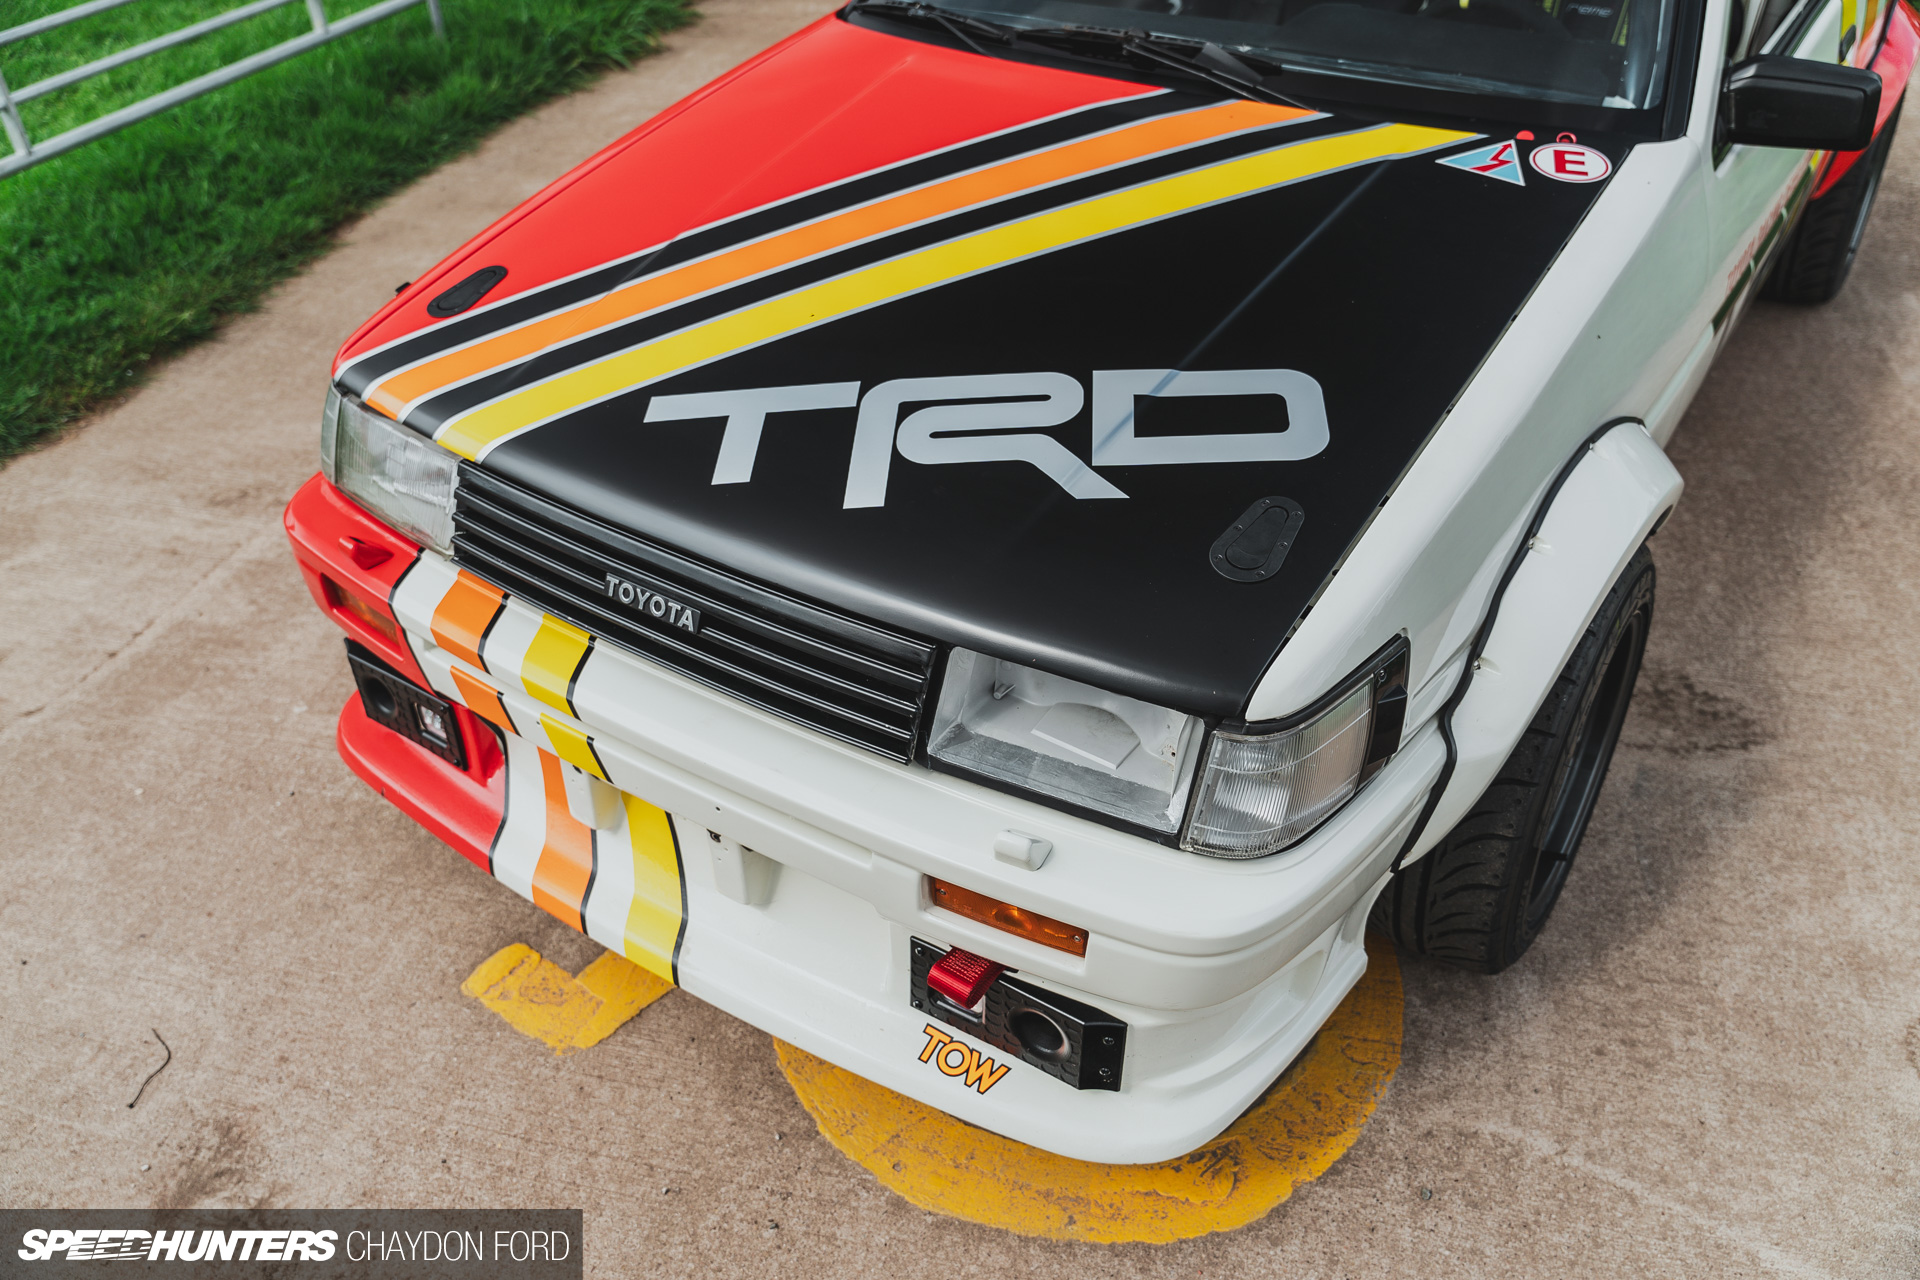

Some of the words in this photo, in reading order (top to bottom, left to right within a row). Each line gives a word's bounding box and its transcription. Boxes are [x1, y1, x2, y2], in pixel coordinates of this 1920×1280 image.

[1553, 149, 1588, 176] E
[643, 368, 1330, 509] TRD
[605, 574, 694, 632] TOYOTA
[918, 1023, 1012, 1095] TOW
